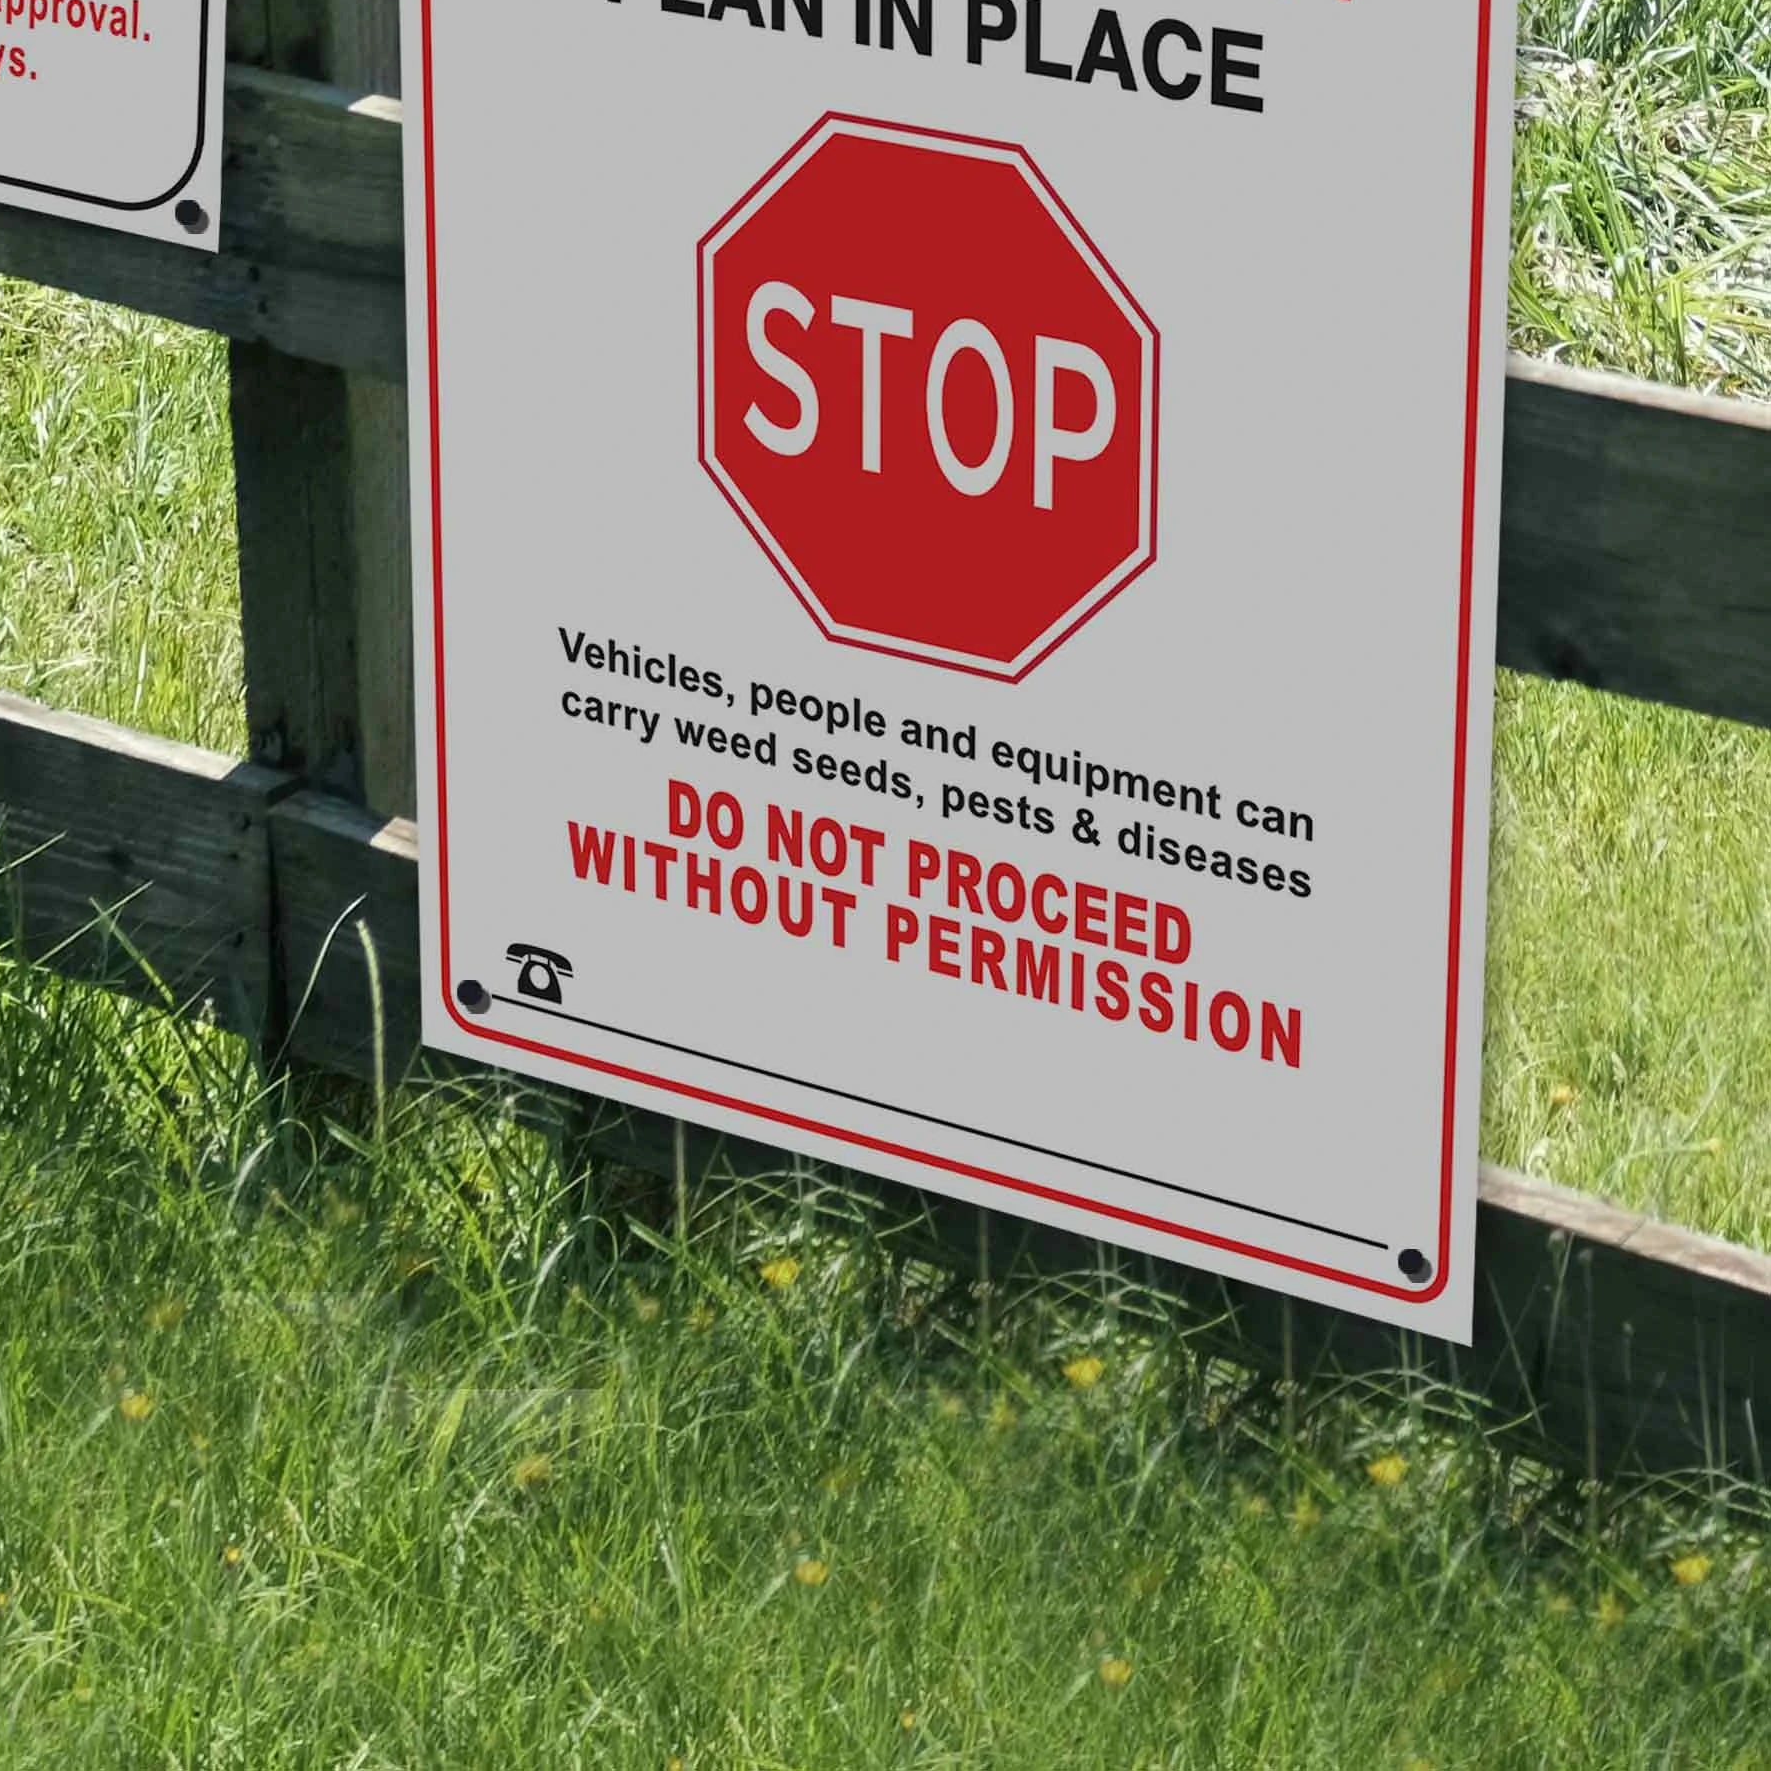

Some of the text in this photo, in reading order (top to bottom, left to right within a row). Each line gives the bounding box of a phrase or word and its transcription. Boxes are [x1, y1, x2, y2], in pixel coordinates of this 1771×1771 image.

[743, 281, 1117, 510] STOP
[558, 626, 1314, 842] Vehicles, people and equipment can
[561, 691, 1312, 898] carry weed seeds, pests & diseases
[567, 820, 1302, 1069] WITHOUT PERMISSION
[667, 779, 1192, 965] DO NOT PROCEED
